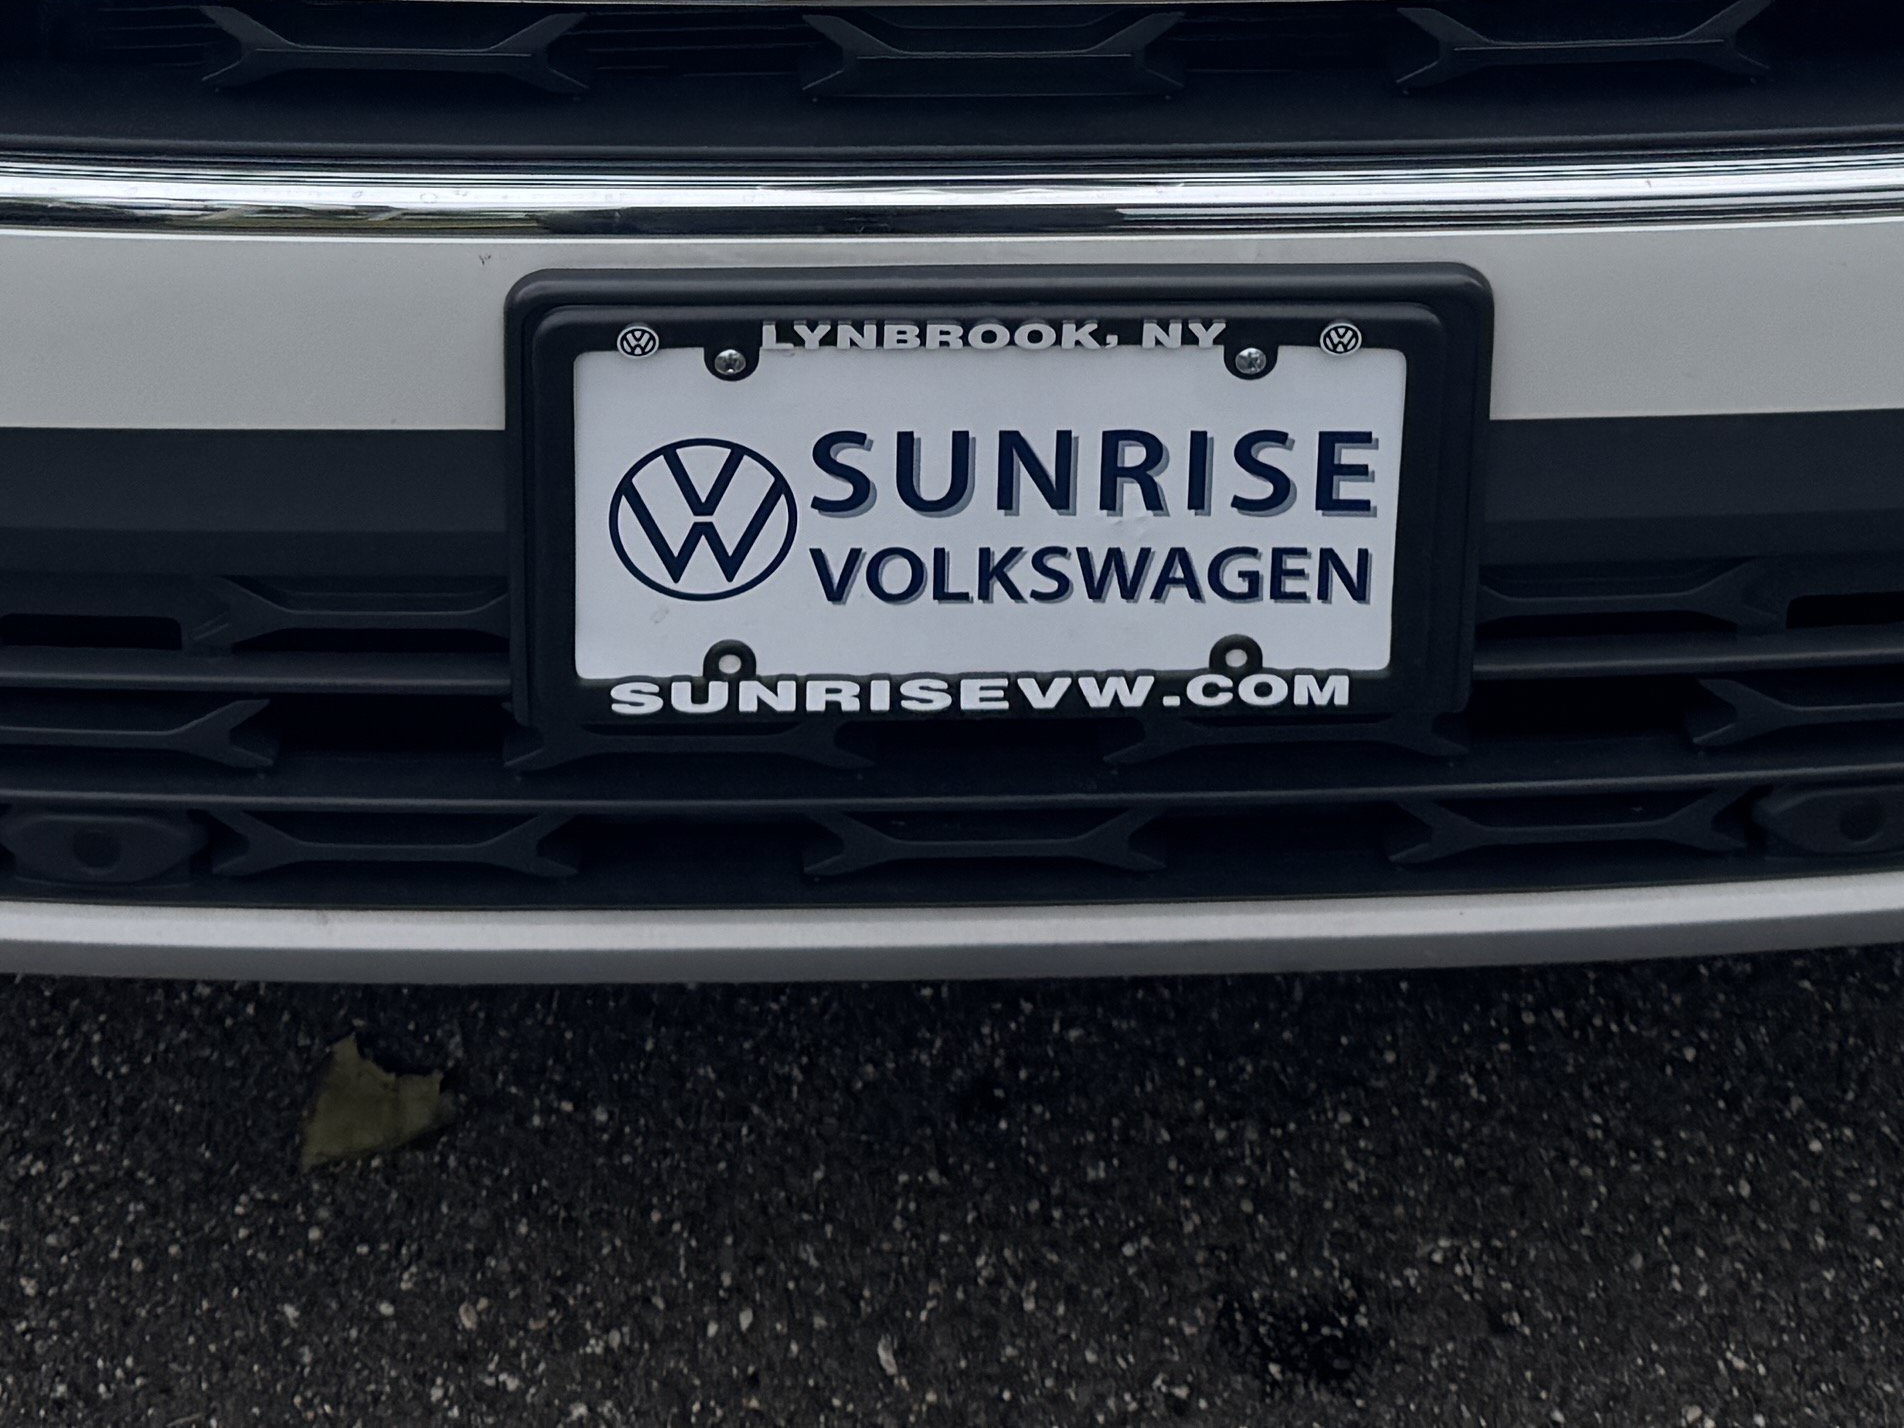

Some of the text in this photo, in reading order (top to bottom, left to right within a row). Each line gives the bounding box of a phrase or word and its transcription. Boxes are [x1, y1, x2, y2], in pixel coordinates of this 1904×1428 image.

[761, 320, 1227, 350] LYNBROOK, NY
[810, 429, 1380, 518] SUNRISE
[614, 442, 792, 594] VW
[808, 546, 1373, 605] VOLKSWAGEN
[609, 673, 1351, 715] SUNRISEVW.COM
